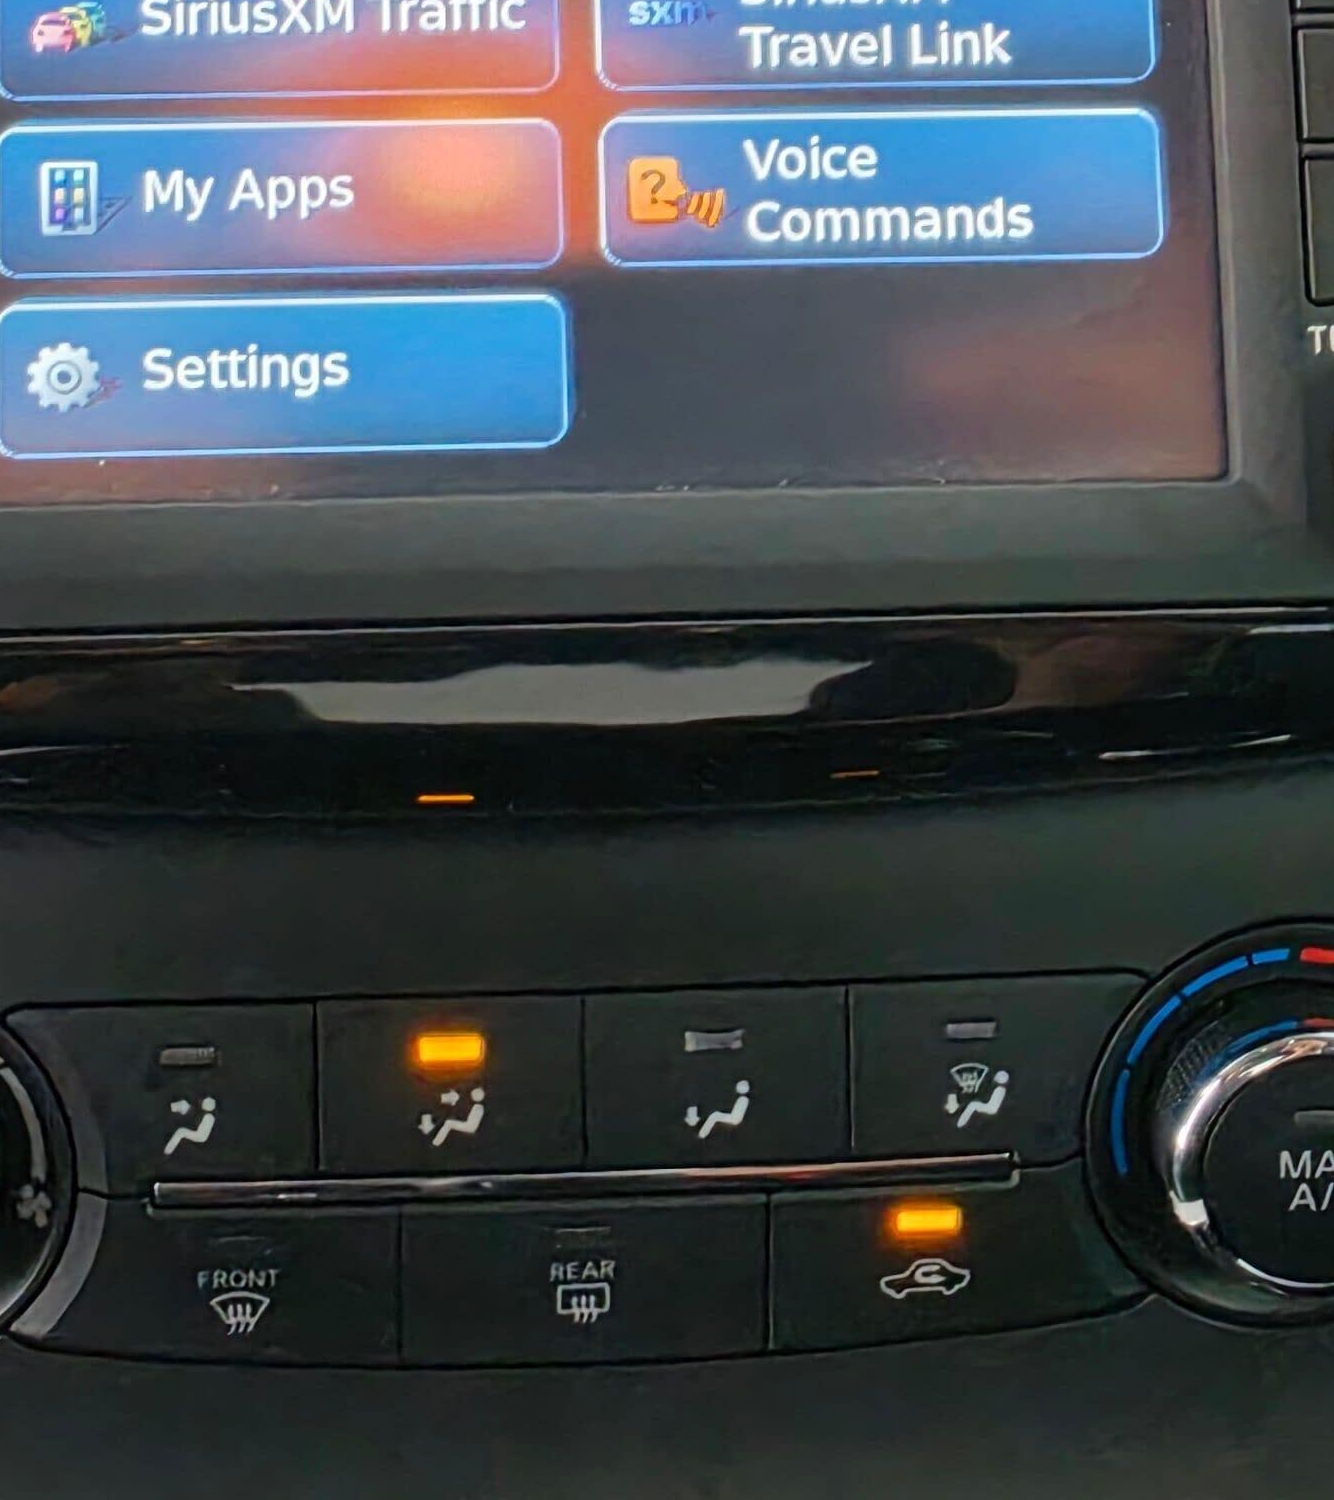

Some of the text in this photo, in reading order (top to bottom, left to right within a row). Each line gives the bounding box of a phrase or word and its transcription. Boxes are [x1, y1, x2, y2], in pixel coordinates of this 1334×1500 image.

[738, 21, 1012, 69] Travel Link
[742, 135, 879, 181] Voice
[143, 168, 355, 221] My Apps
[746, 196, 1034, 244] Commands
[142, 342, 351, 398] Settings
[196, 1268, 281, 1291] FRONT
[548, 1258, 617, 1283] REAR
